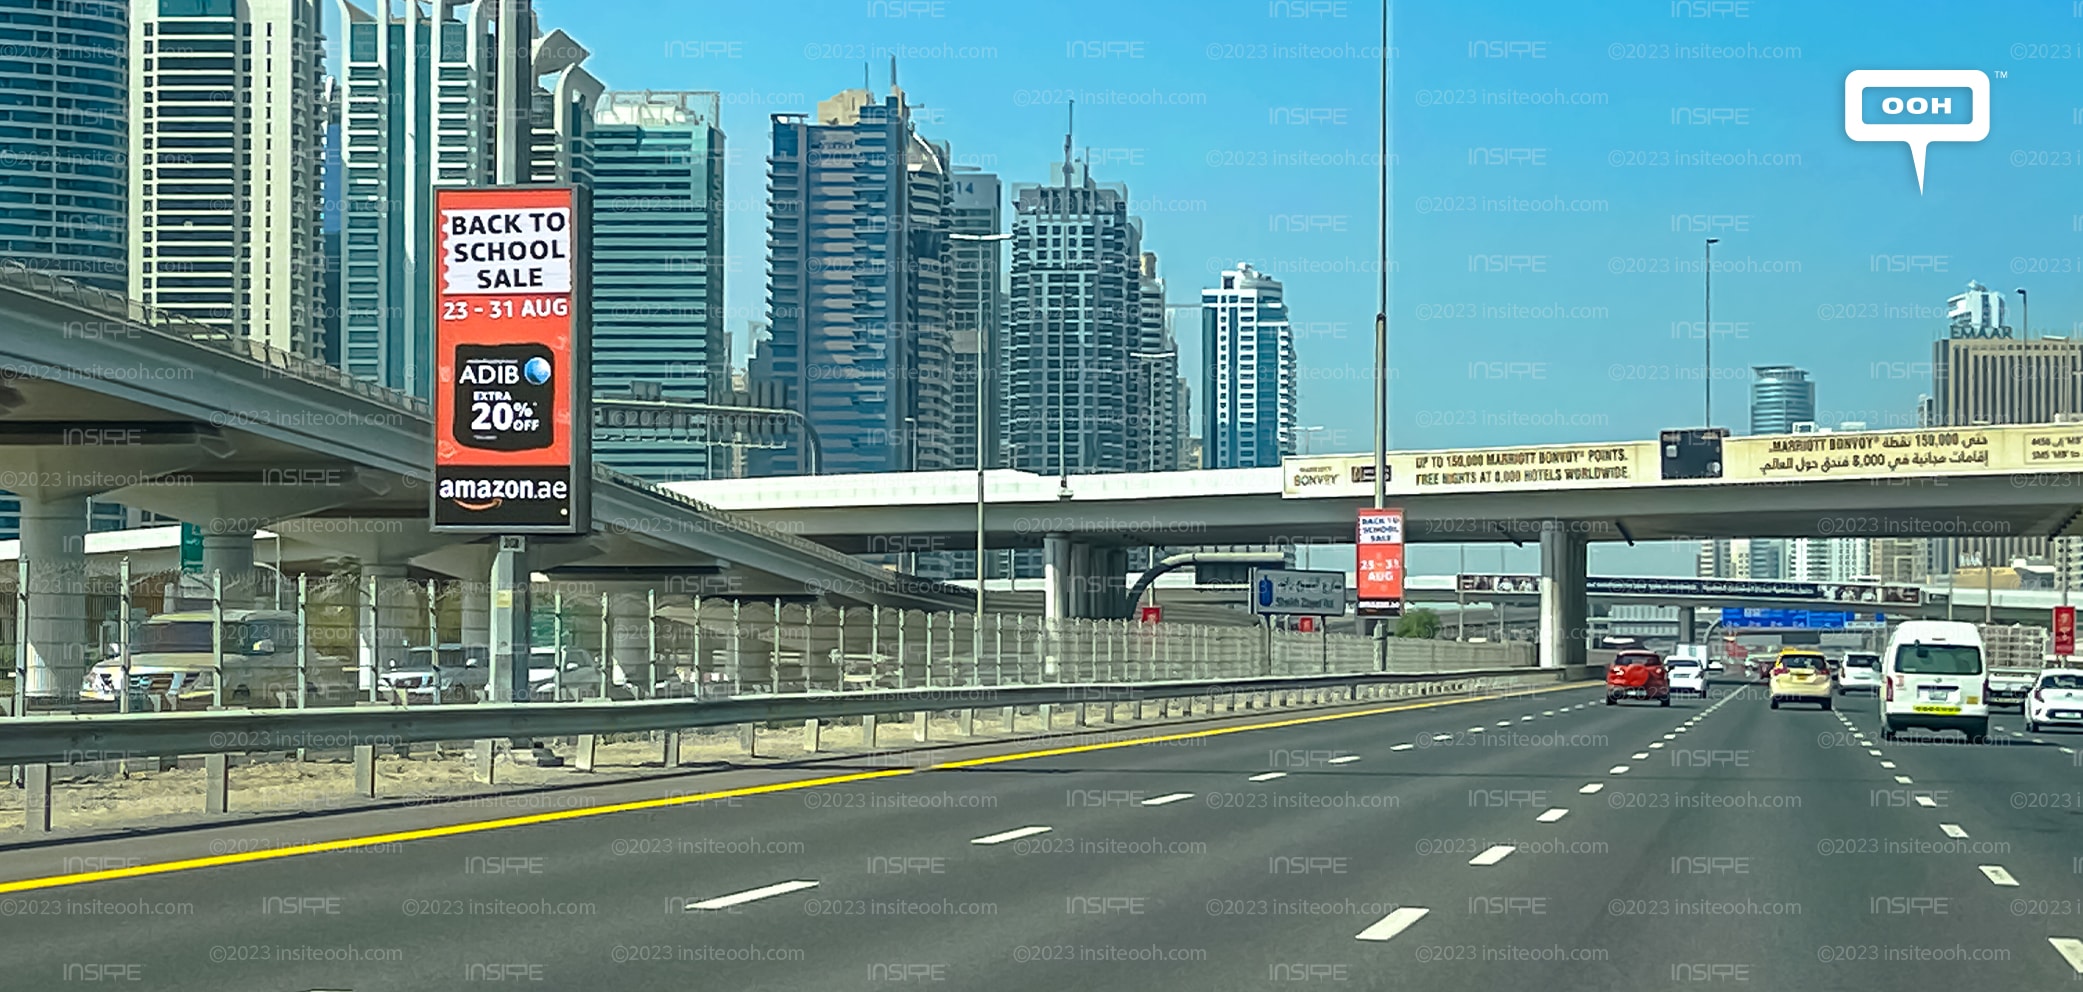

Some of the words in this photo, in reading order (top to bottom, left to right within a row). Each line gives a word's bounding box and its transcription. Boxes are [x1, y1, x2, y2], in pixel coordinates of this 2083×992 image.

[452, 214, 522, 236] BACK
[529, 212, 566, 233] TO
[454, 239, 565, 263] SCHOOL
[477, 267, 543, 289] SALE
[443, 301, 468, 320] 23
[489, 299, 513, 318] 31
[521, 297, 568, 318] AUG
[1950, 325, 2013, 339] EMAAR
[459, 364, 520, 384] ADIB
[473, 391, 512, 401] EXTRA
[513, 419, 540, 431] OFF
[1882, 436, 1911, 448] نقطة
[1915, 433, 1959, 449] 150,000
[1962, 436, 1988, 449] حتى
[1416, 456, 1428, 468] UP
[1432, 455, 1444, 468] TO
[1486, 452, 1536, 466] MARRIOTT
[1796, 457, 1819, 472] حول
[1821, 458, 1849, 473] فندق
[1852, 454, 1885, 469] 8,000
[1887, 457, 1910, 472] في
[1912, 452, 1947, 466] مجانية
[1950, 450, 1989, 468] إقامات
[1416, 472, 1439, 486] FREE
[1442, 470, 1477, 485] NIGHTS
[1479, 470, 1492, 483] AT
[1524, 467, 1562, 482] HOTELS
[439, 478, 568, 499] amazon.ae
[1368, 571, 1393, 581] AUG
